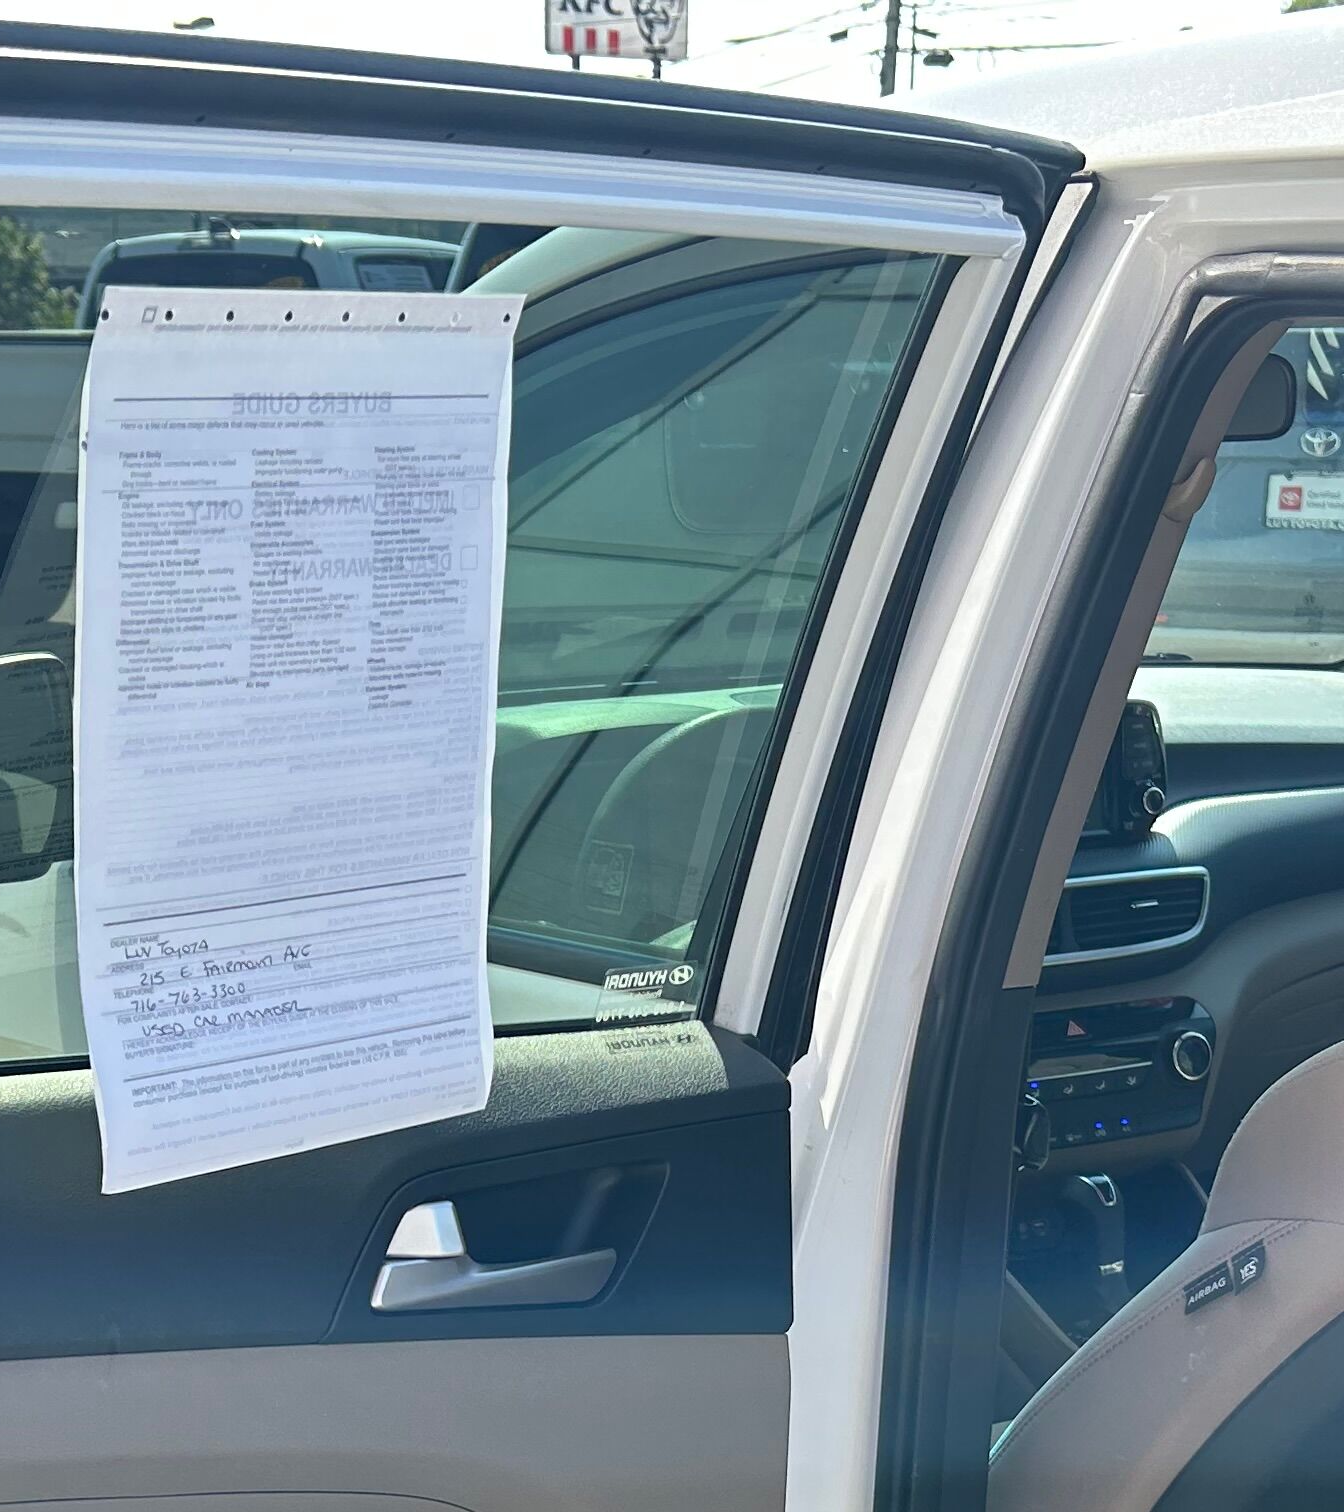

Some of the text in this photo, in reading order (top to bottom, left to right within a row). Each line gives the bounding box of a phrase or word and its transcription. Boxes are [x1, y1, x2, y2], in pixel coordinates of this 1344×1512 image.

[140, 971, 166, 987] 215
[180, 966, 192, 978] E
[130, 982, 246, 1013] 716-763-3300
[1240, 1260, 1257, 1280] YES
[1188, 1276, 1226, 1306] AIRBAG
